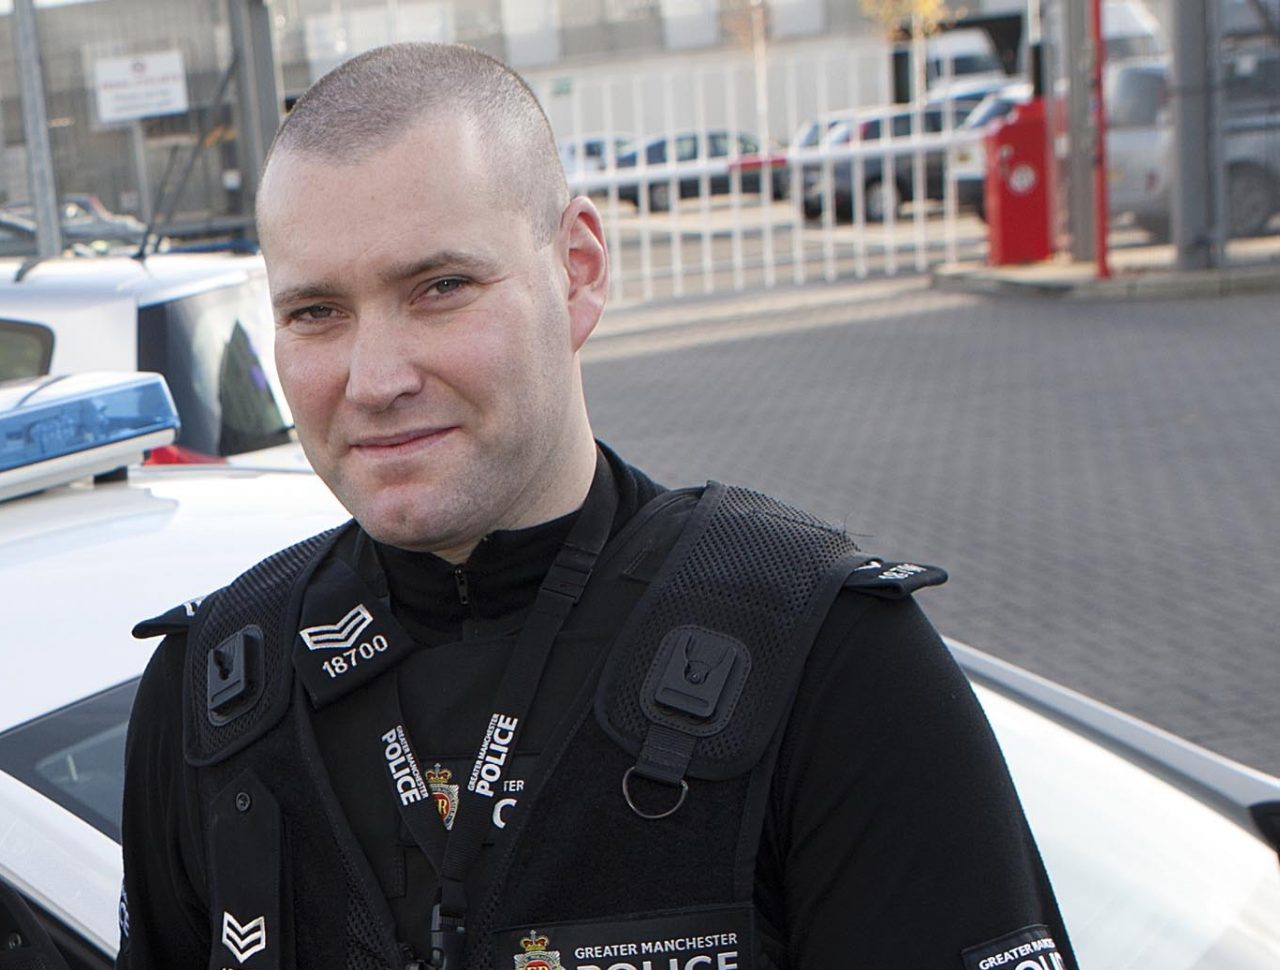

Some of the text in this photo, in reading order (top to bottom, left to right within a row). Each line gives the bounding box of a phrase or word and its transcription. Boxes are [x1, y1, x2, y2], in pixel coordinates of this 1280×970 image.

[322, 635, 389, 679] 18700
[381, 728, 422, 806] POLICE
[395, 725, 429, 800] GREATER MANCHESTER
[467, 713, 500, 792] GREATER MANCHESTER
[475, 714, 518, 797] POLICE
[574, 932, 738, 960] GREATER MANCHESTER
[978, 943, 1033, 970] GREATER
